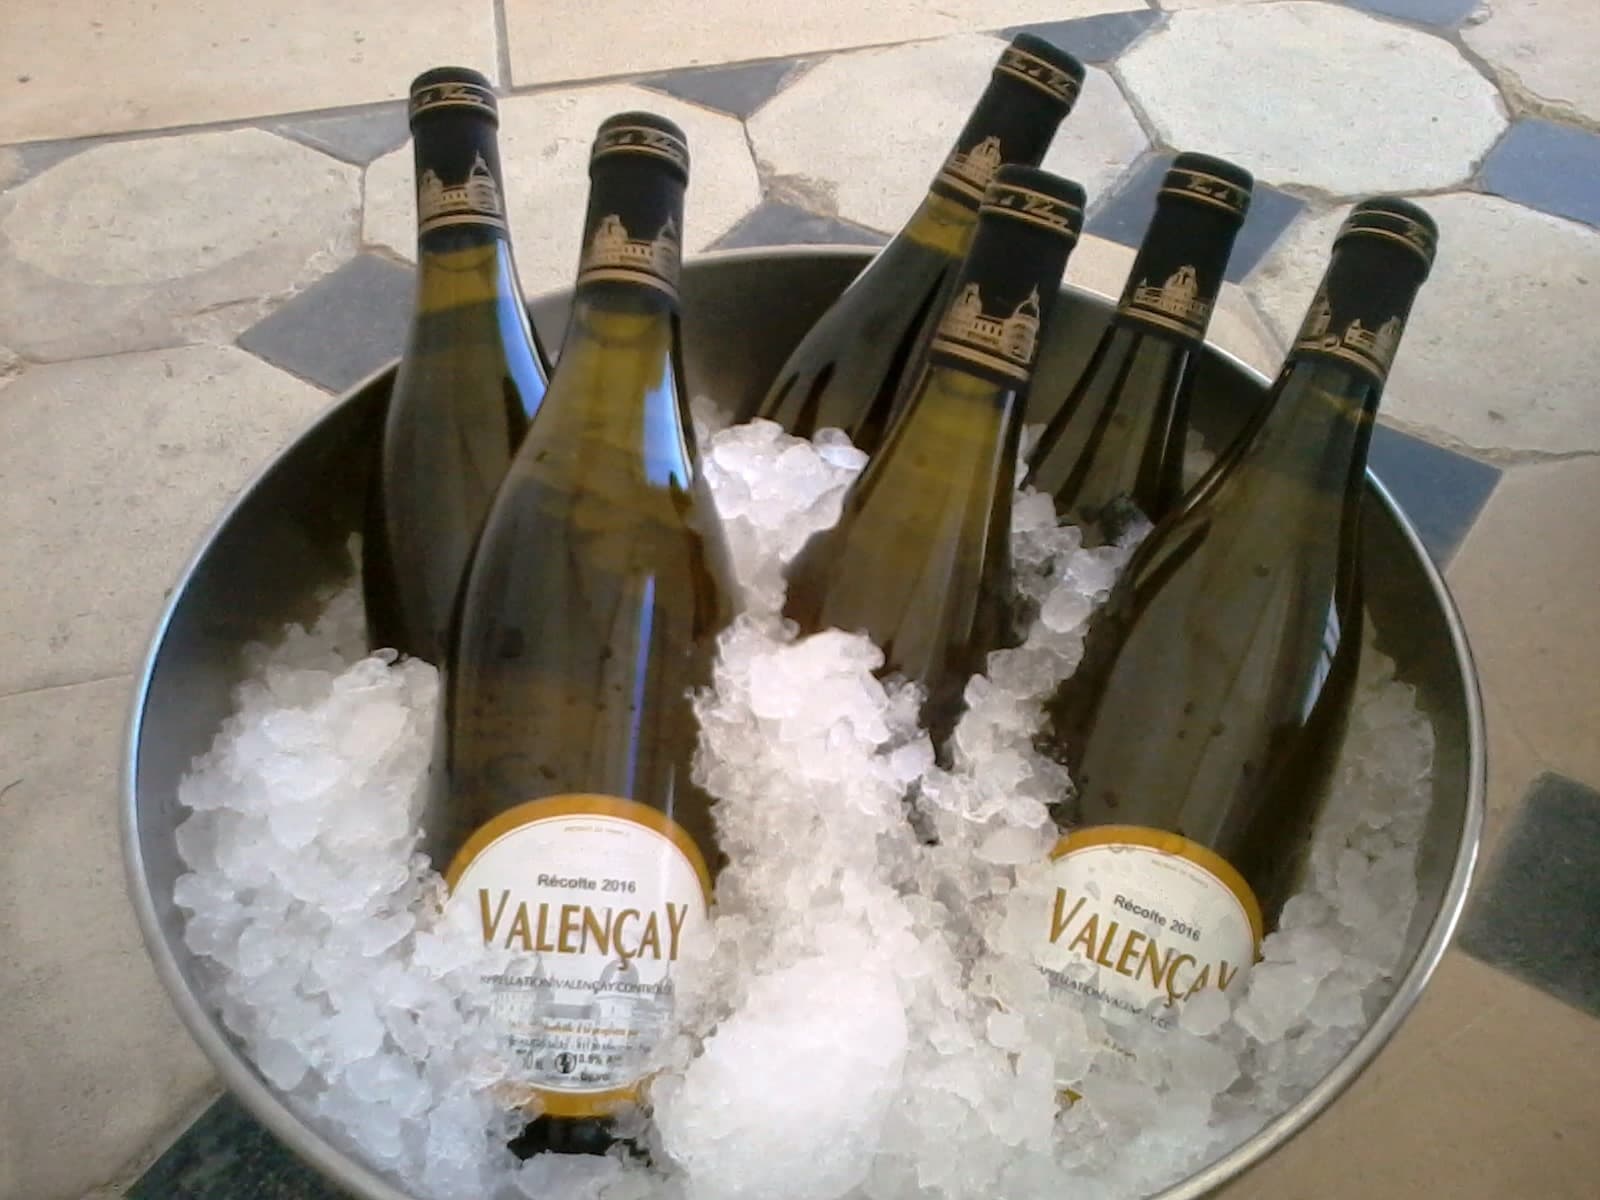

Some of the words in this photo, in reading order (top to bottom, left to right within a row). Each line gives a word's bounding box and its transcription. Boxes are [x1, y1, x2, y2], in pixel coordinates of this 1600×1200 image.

[537, 873, 597, 891] Récolte
[601, 878, 636, 895] 2016
[478, 888, 689, 971] VALENÇAY
[1113, 893, 1168, 927] Récolte
[1169, 918, 1202, 942] 2016
